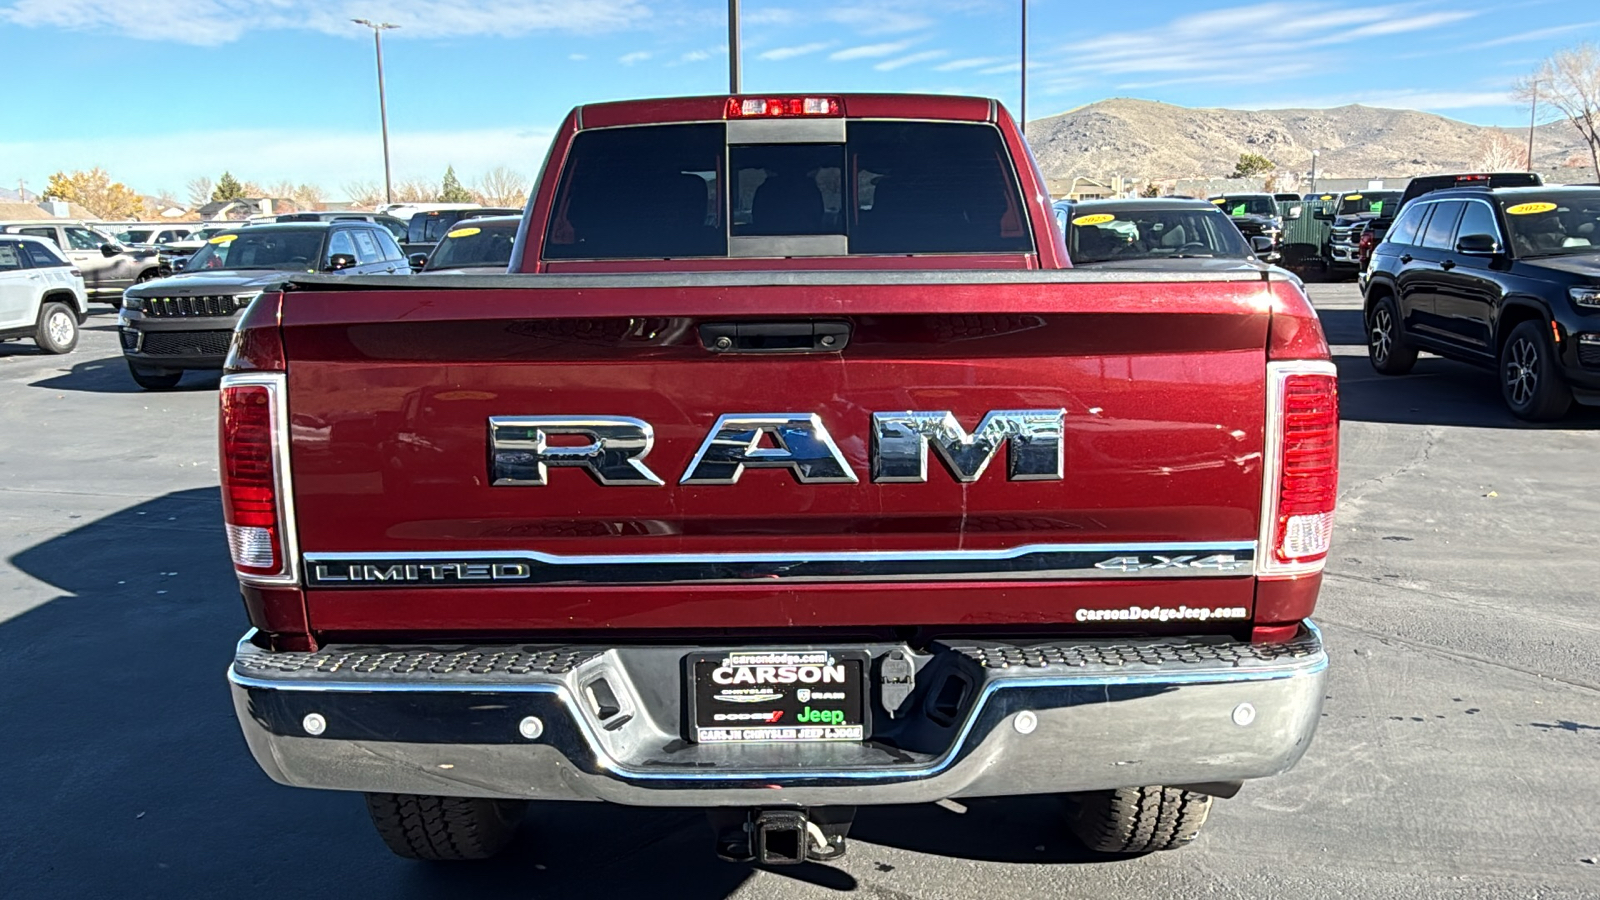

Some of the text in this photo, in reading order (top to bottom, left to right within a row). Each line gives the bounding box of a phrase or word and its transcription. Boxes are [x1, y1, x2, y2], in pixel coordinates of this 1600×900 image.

[1518, 204, 1547, 212] 2025
[488, 409, 1067, 486] RAM
[315, 564, 531, 581] LIMITED
[1075, 605, 1247, 622] CarsonDodgeJeep.com
[732, 653, 826, 665] carsondodge.com
[712, 665, 845, 684] CARSON
[811, 692, 846, 700] RAM
[713, 713, 773, 721] DODGE
[797, 706, 844, 725] Jeep
[743, 728, 797, 740] CHRYSLER
[798, 728, 824, 739] JEEP
